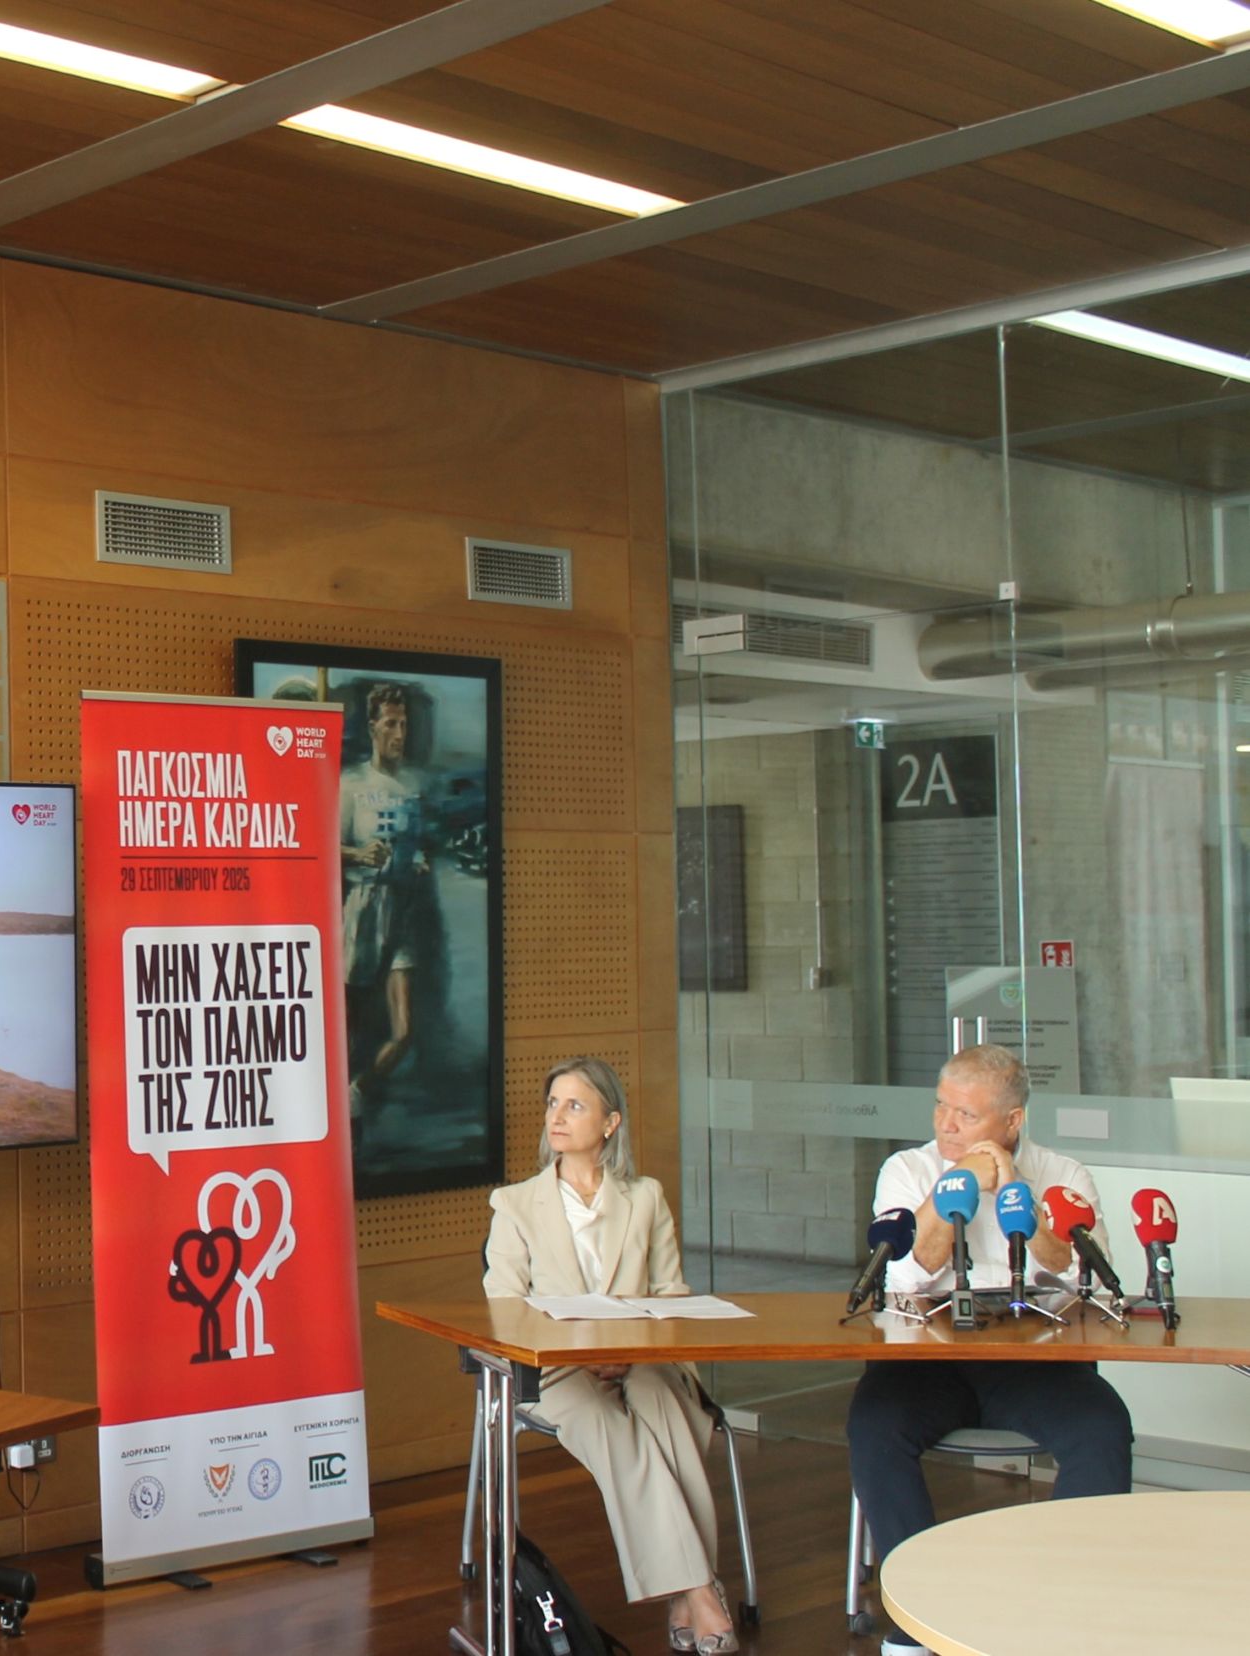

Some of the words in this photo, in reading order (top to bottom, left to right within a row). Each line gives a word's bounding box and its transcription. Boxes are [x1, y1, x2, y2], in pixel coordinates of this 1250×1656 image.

[295, 727, 326, 738] WORLD
[297, 738, 323, 748] HEART
[297, 748, 314, 758] DAY
[117, 749, 248, 799] ΠΑΓΚΟΣΜΙΑ
[896, 752, 958, 809] 2A
[119, 800, 198, 848] ΗΜΕΡΑ
[205, 802, 300, 849] ΚΑΡΔΙΑΣ
[121, 867, 136, 892] 29
[139, 867, 218, 892] ΣΕΠΤΕΜΒΡΙΟΥ
[222, 867, 250, 891] 2025
[135, 943, 200, 1005] ΜΗΝ
[211, 941, 313, 1002] ΧΑΣΕΙΣ
[136, 1007, 193, 1070] ΤΟΝ
[204, 1003, 307, 1067] ΠΑΛΜΟ
[138, 1072, 193, 1135] ΤΗΣ
[204, 1068, 275, 1131] ΖΩΗΣ
[294, 1420, 328, 1433] ΕΥΓΕΝΙΚΗ
[329, 1416, 360, 1429] ΧΟΡΗΓΙΑ
[209, 1435, 225, 1446] ΥΠΟ
[227, 1433, 242, 1443] ΤΗΝ
[243, 1430, 268, 1441] ΑΙΓΙΔΑ
[120, 1444, 171, 1459] ΔΙΟΡΓΑΝΩΣΗ
